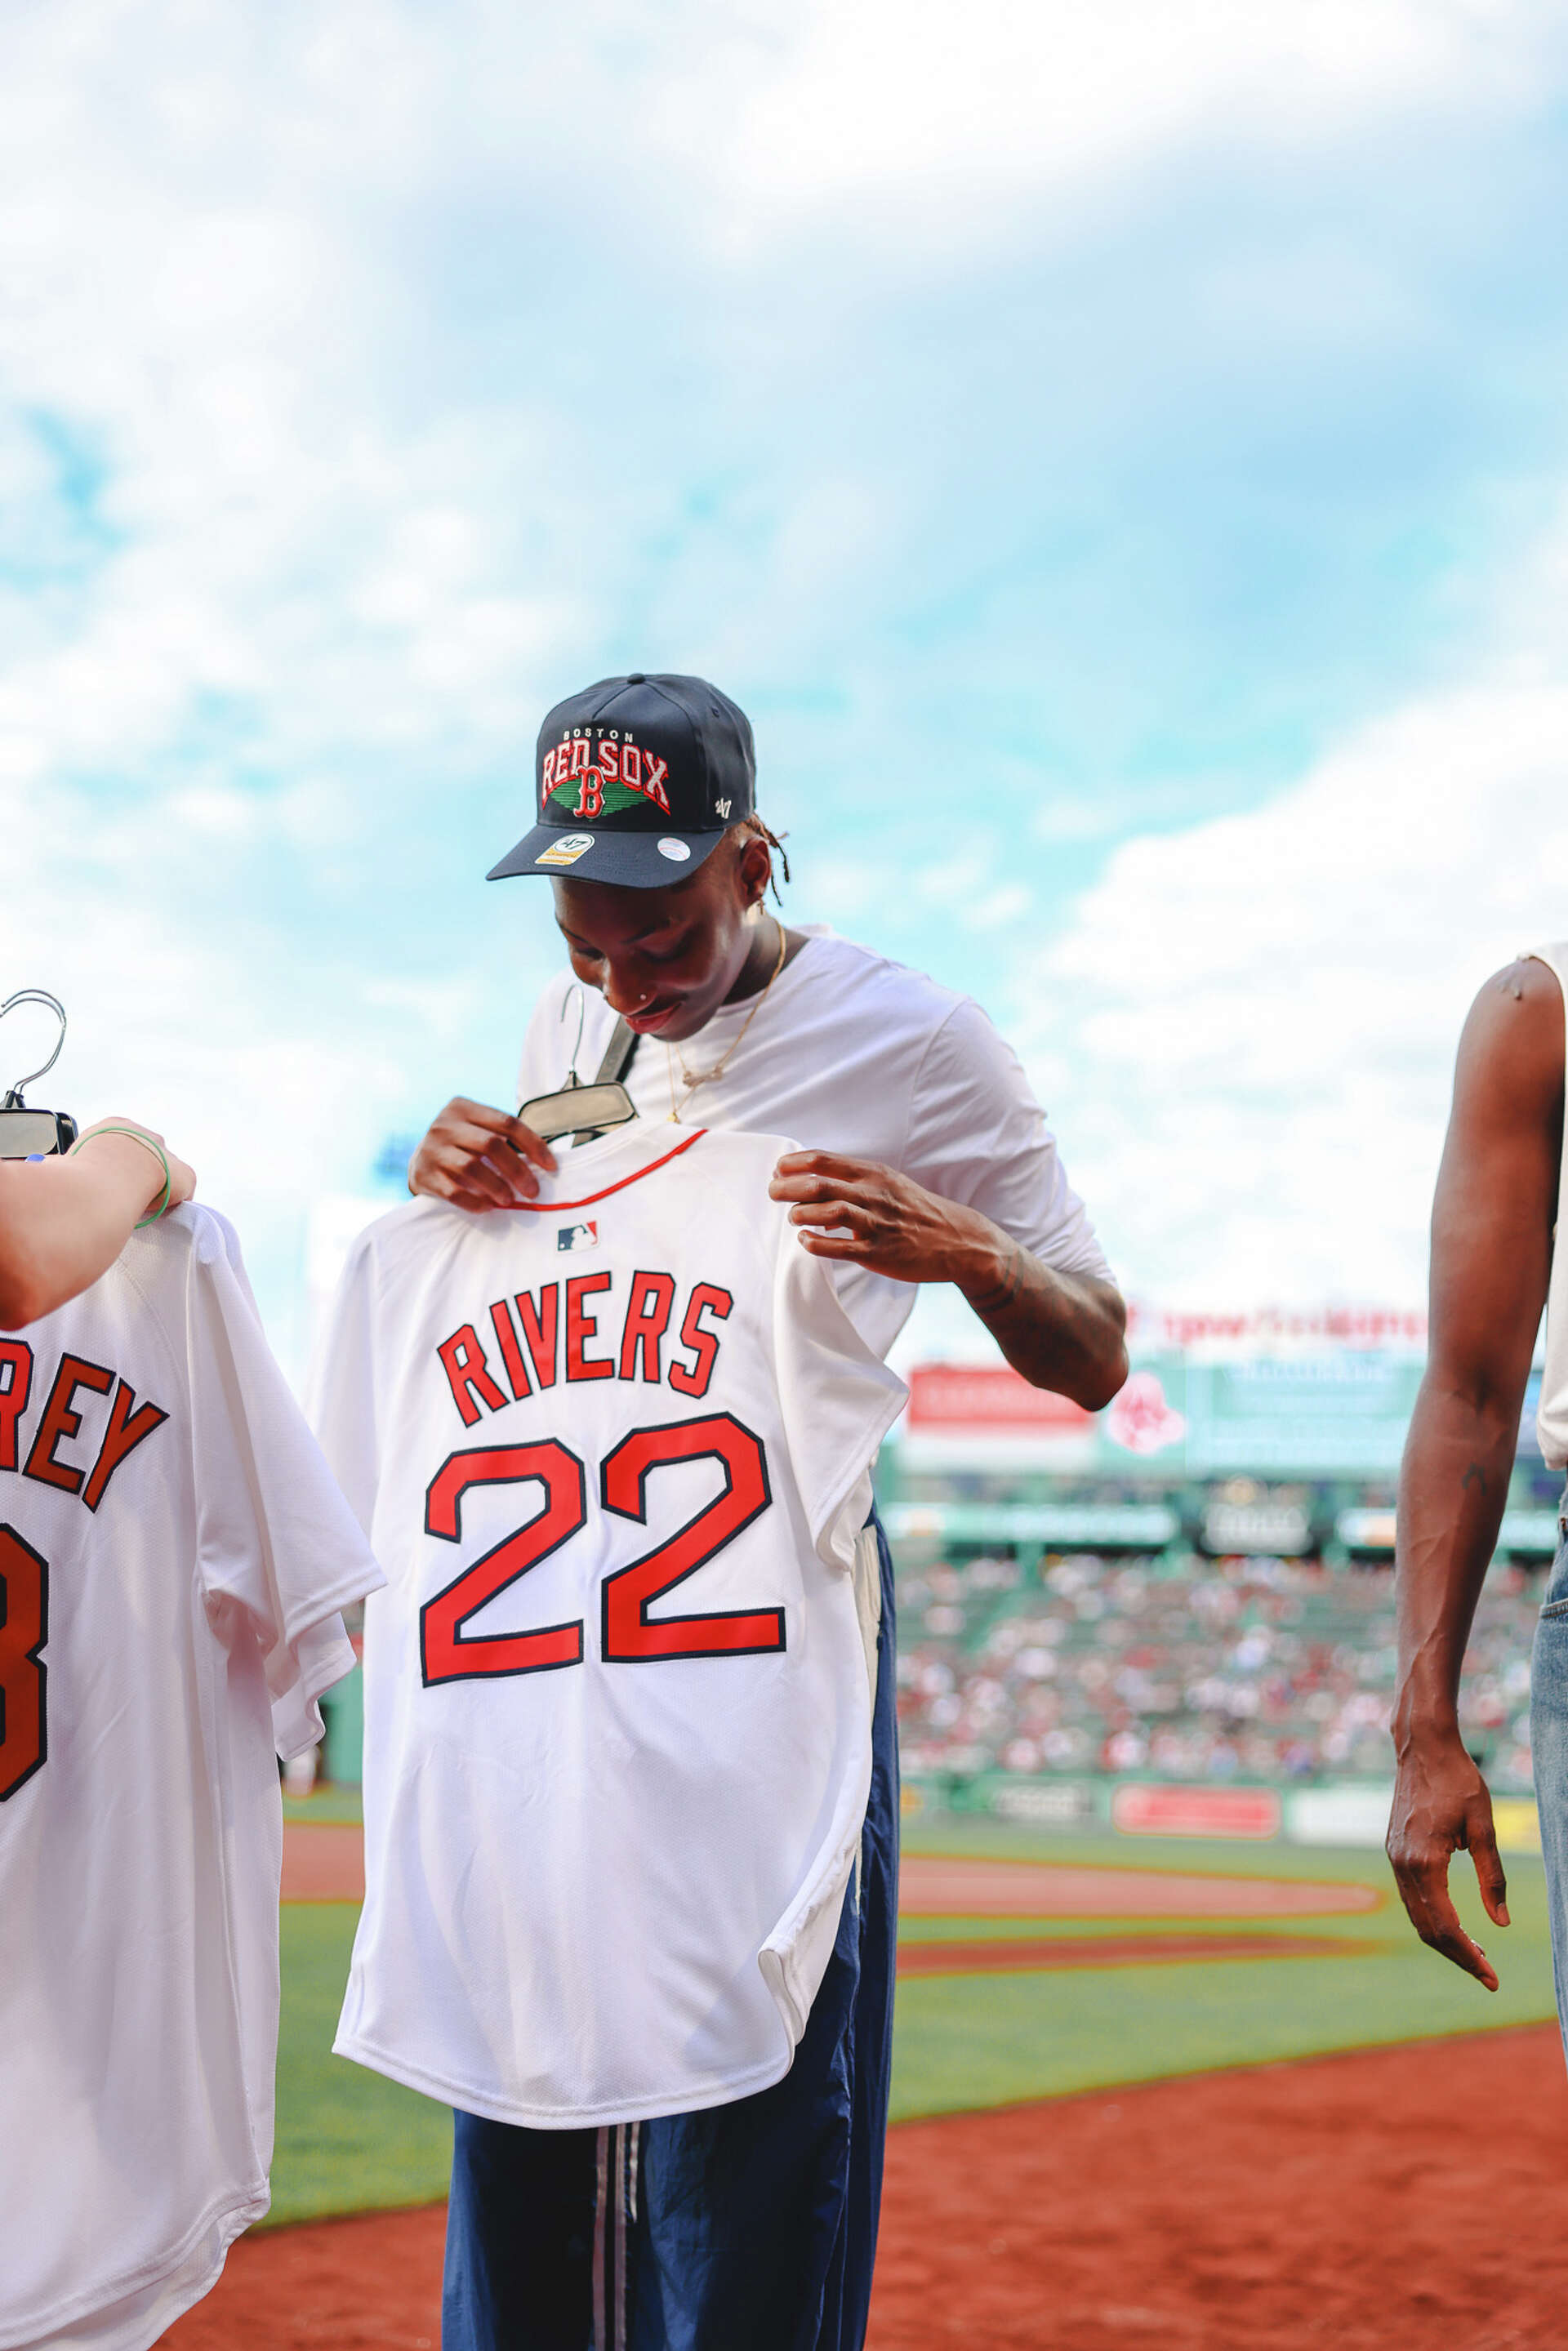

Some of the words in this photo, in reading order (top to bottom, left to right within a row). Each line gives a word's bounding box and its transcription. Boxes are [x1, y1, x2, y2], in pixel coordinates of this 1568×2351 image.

[564, 728, 634, 743] BOSTON
[542, 737, 590, 810] RED
[598, 739, 670, 816] SOX
[573, 765, 606, 818] B
[437, 1270, 734, 1428] RIVERS
[420, 1411, 786, 1688] 22
